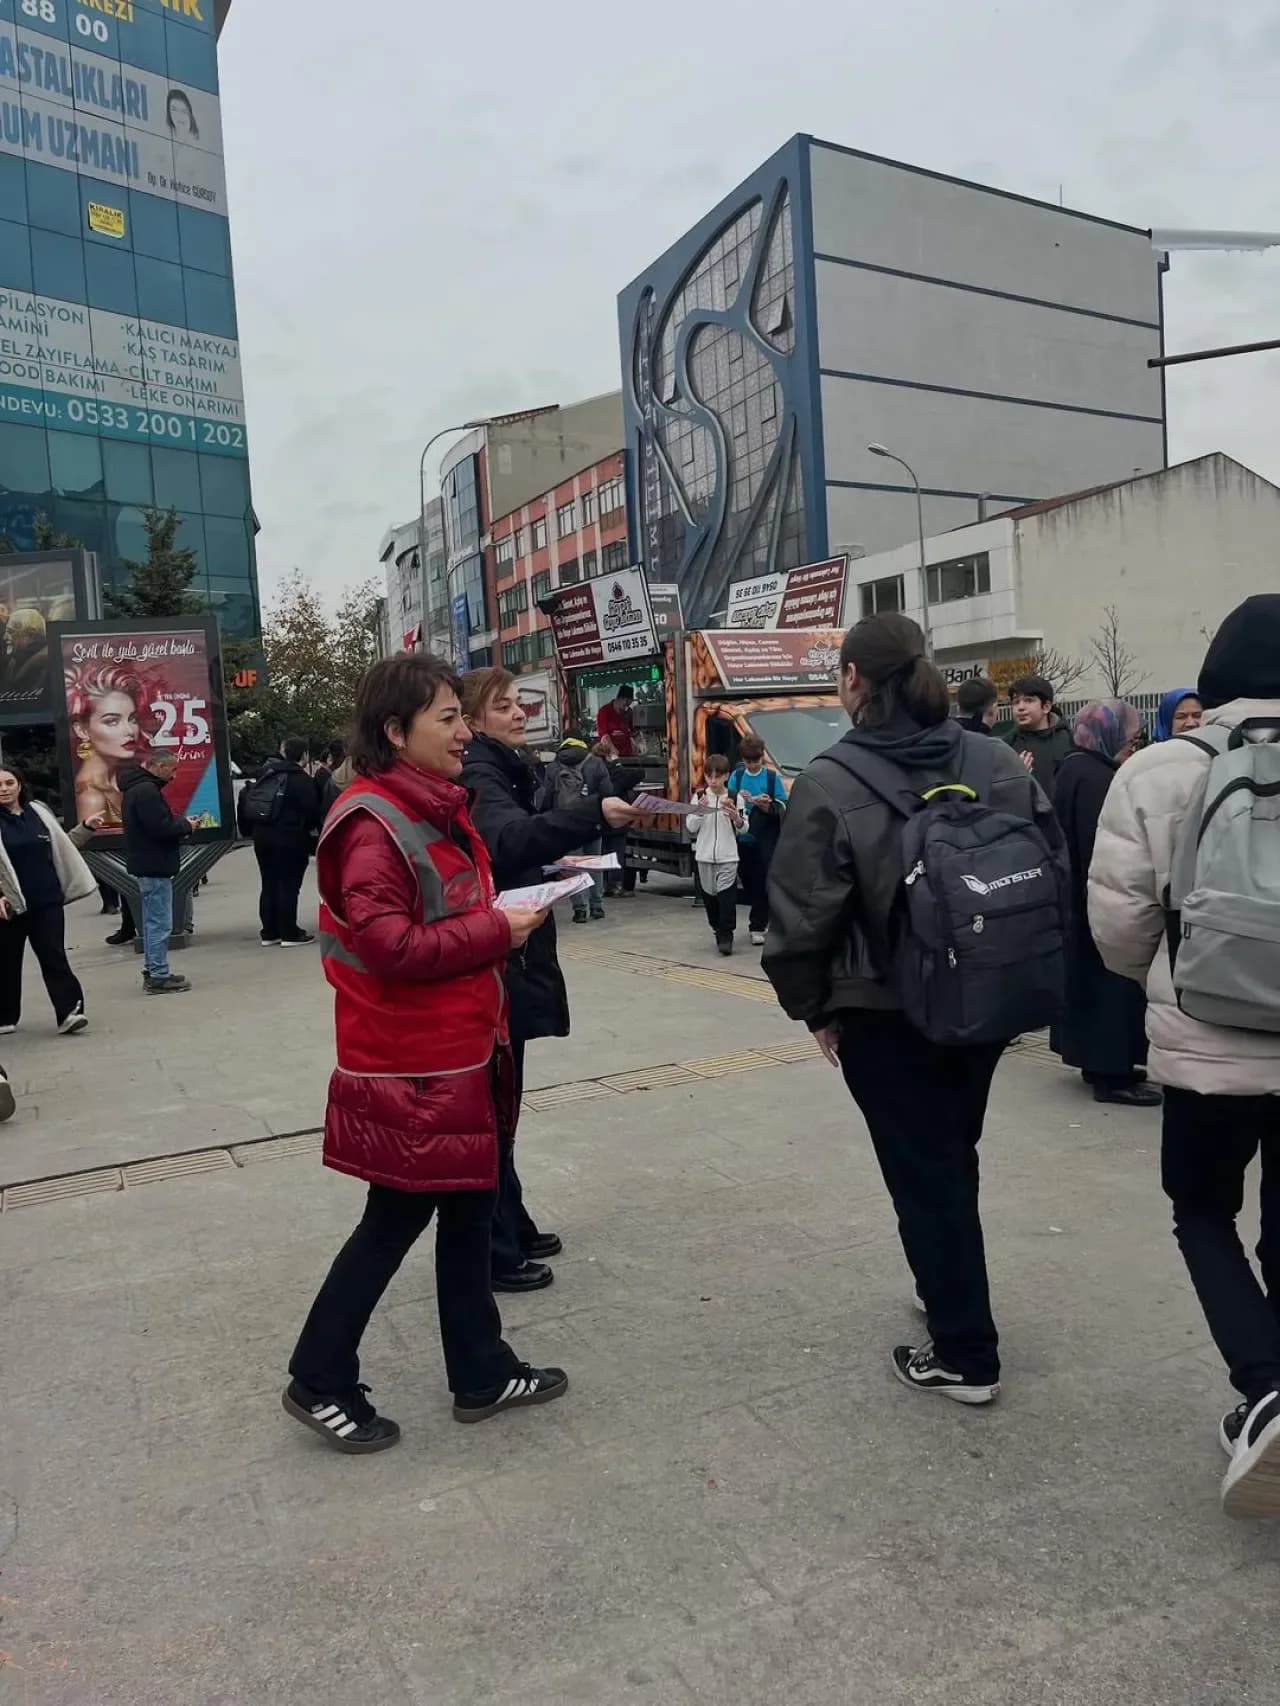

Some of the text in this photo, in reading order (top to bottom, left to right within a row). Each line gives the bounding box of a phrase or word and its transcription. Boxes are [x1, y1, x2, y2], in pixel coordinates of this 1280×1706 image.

[21, 0, 108, 42] 88 00
[0, 37, 147, 120] ASTALIKLARI
[0, 102, 139, 179] UM UZMANI
[126, 322, 237, 359] KALICI MAKYAJ
[25, 344, 120, 375] ZAYIFLAMA
[127, 342, 225, 374] KAŞ TASARIM
[46, 369, 105, 393] BAKIMI
[165, 371, 218, 393] BAKIMI
[67, 399, 129, 430] 0533
[131, 386, 239, 417] LEKE ONARIMI
[944, 663, 983, 684] Bank
